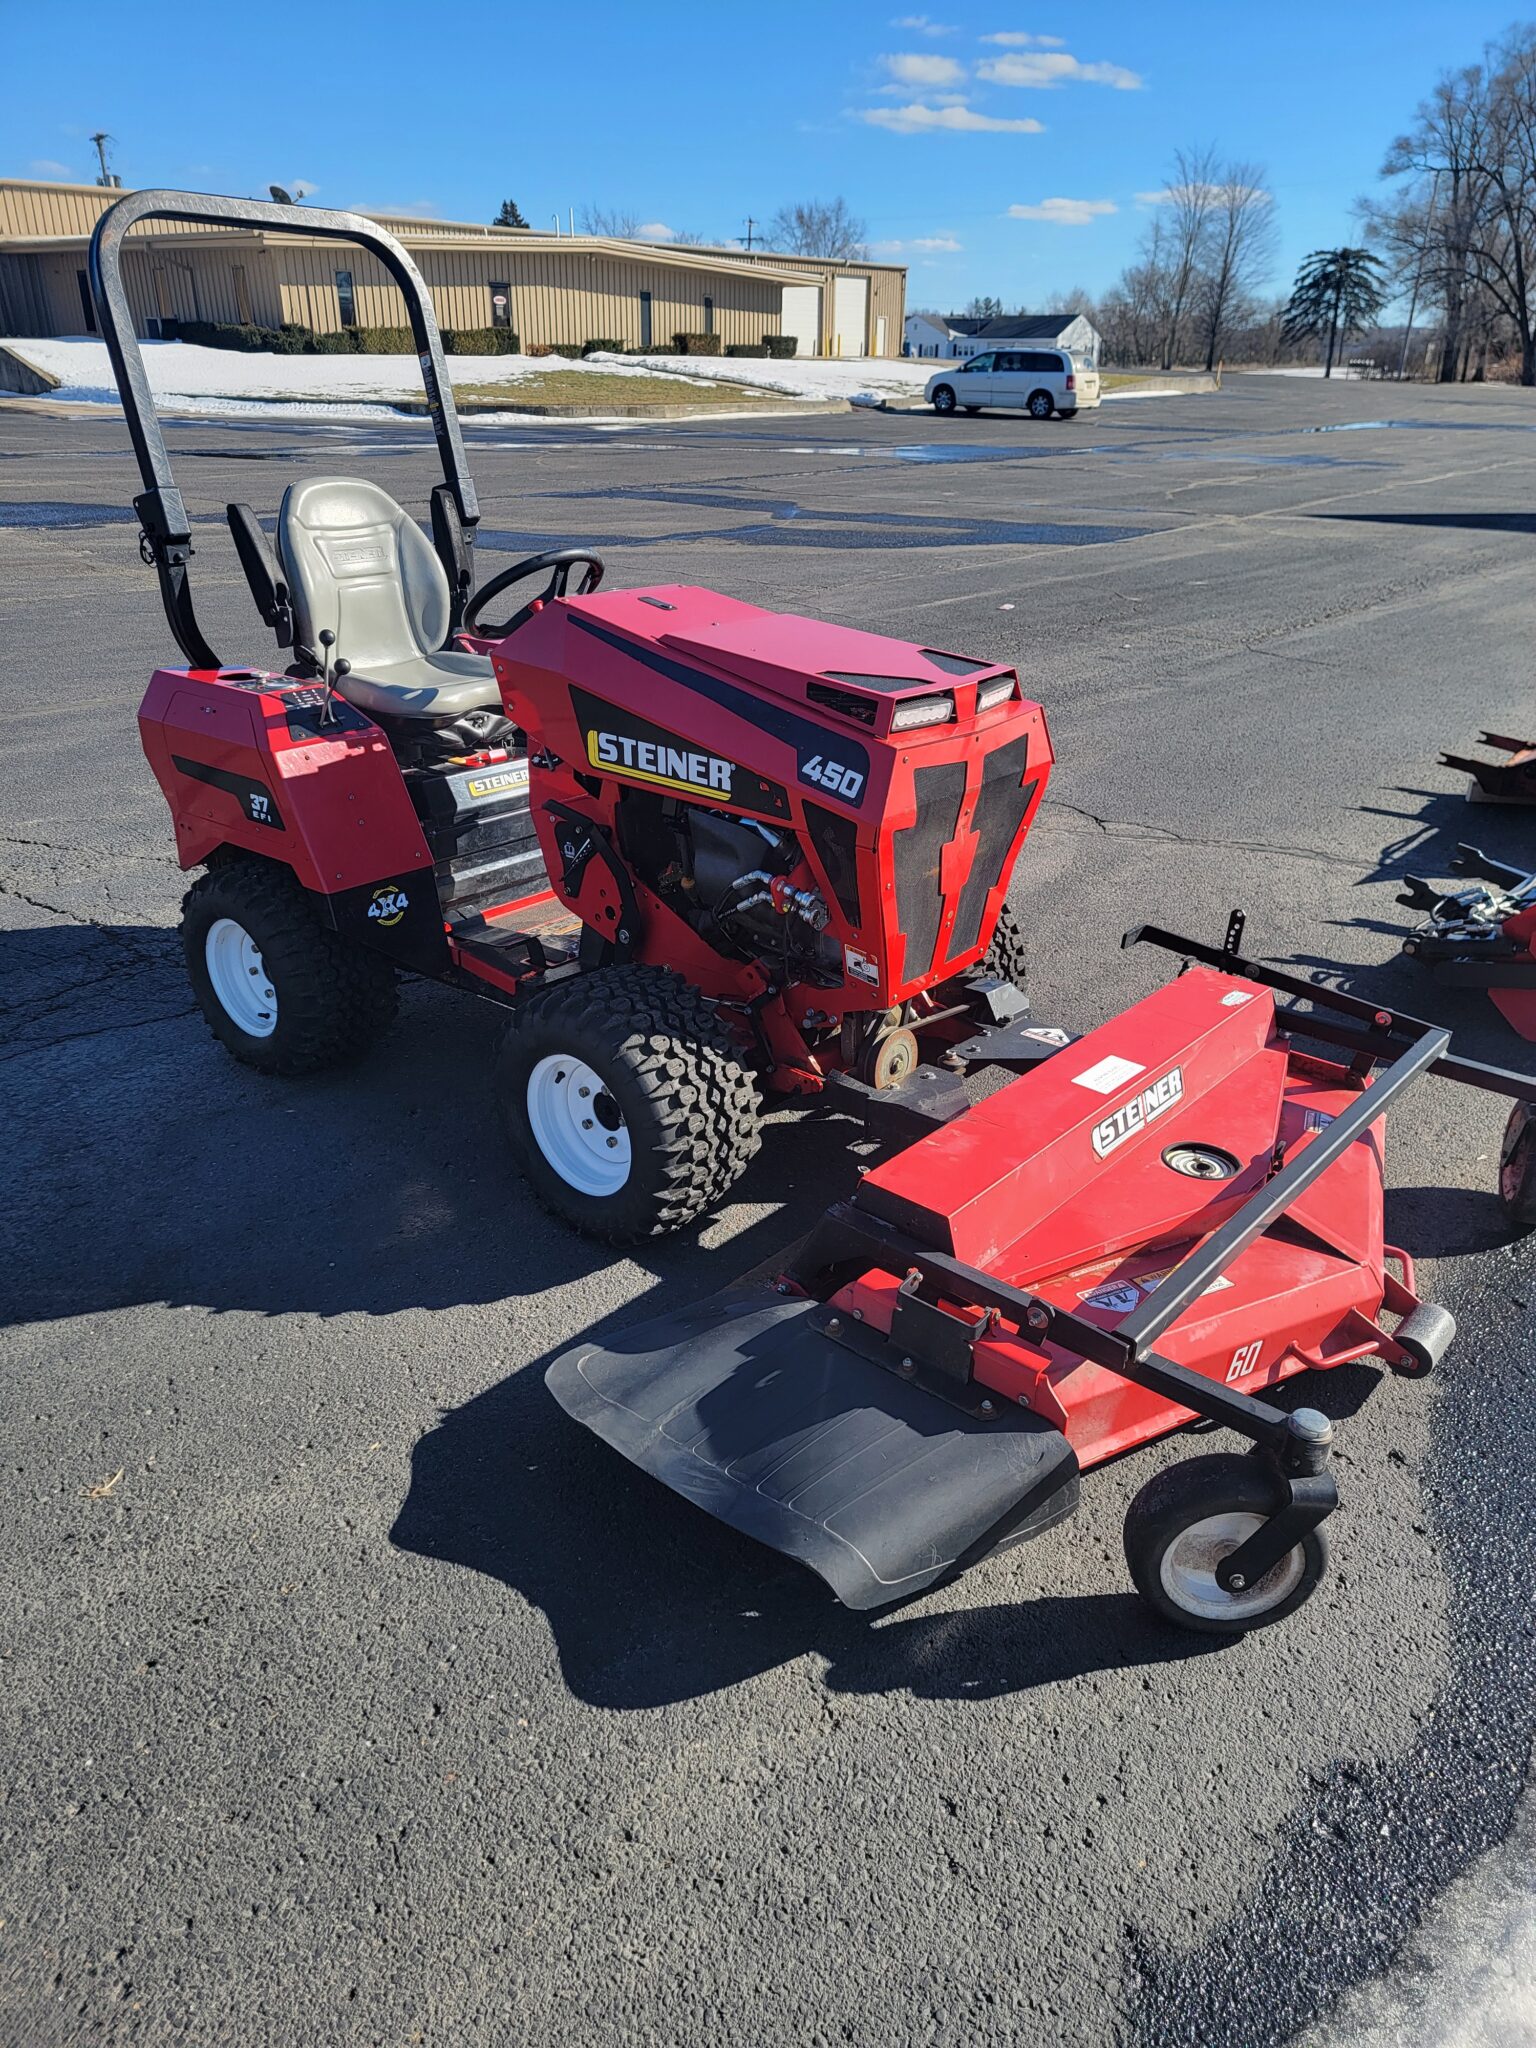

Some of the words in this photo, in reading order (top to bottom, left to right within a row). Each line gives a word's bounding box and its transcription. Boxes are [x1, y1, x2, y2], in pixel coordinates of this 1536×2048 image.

[598, 732, 732, 791] STEINER
[802, 755, 864, 798] 450
[250, 793, 268, 812] 37
[253, 811, 272, 822] EFI
[367, 893, 409, 917] 4X4
[1098, 1067, 1183, 1149] STEINER
[1225, 1340, 1263, 1382] 60
